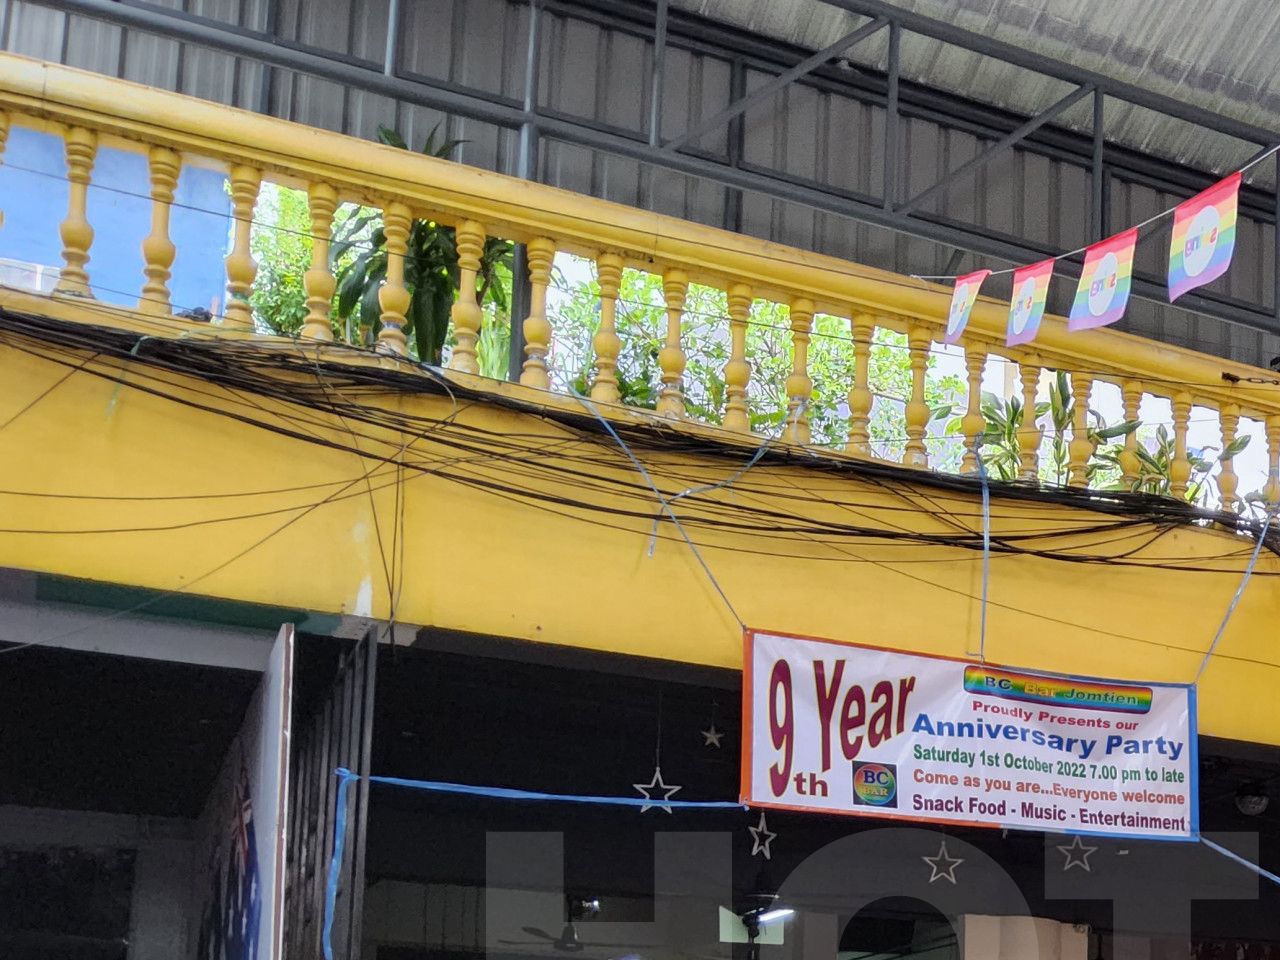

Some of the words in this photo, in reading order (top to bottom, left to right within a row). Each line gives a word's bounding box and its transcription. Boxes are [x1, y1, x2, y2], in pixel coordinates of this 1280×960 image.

[985, 676, 1012, 690] BC
[1024, 681, 1057, 698] Bar
[1064, 688, 1139, 705] Jomtien
[769, 658, 794, 798] 9
[812, 659, 917, 773] Year
[972, 700, 1033, 722] Proudly
[1038, 711, 1111, 729] Presents
[1116, 721, 1139, 730] our
[912, 713, 1097, 760] Anniversary
[1105, 735, 1184, 761] Party
[863, 770, 889, 785] BC
[913, 744, 975, 768] Saturday
[980, 750, 1000, 767] 1st
[1004, 753, 1053, 774] October
[1057, 760, 1087, 778] 2022
[1090, 764, 1117, 780] 7.00
[1121, 769, 1141, 784] pm
[1145, 767, 1158, 782] to
[1161, 767, 1185, 783] late
[793, 772, 829, 797] th
[913, 768, 959, 786] Come
[963, 775, 981, 787] as
[985, 778, 1011, 792] you
[1122, 789, 1185, 805] welcome
[912, 793, 963, 813] Snack
[968, 797, 1006, 816] Food
[1021, 802, 1067, 821] Music
[1079, 808, 1186, 831] Entertainment
